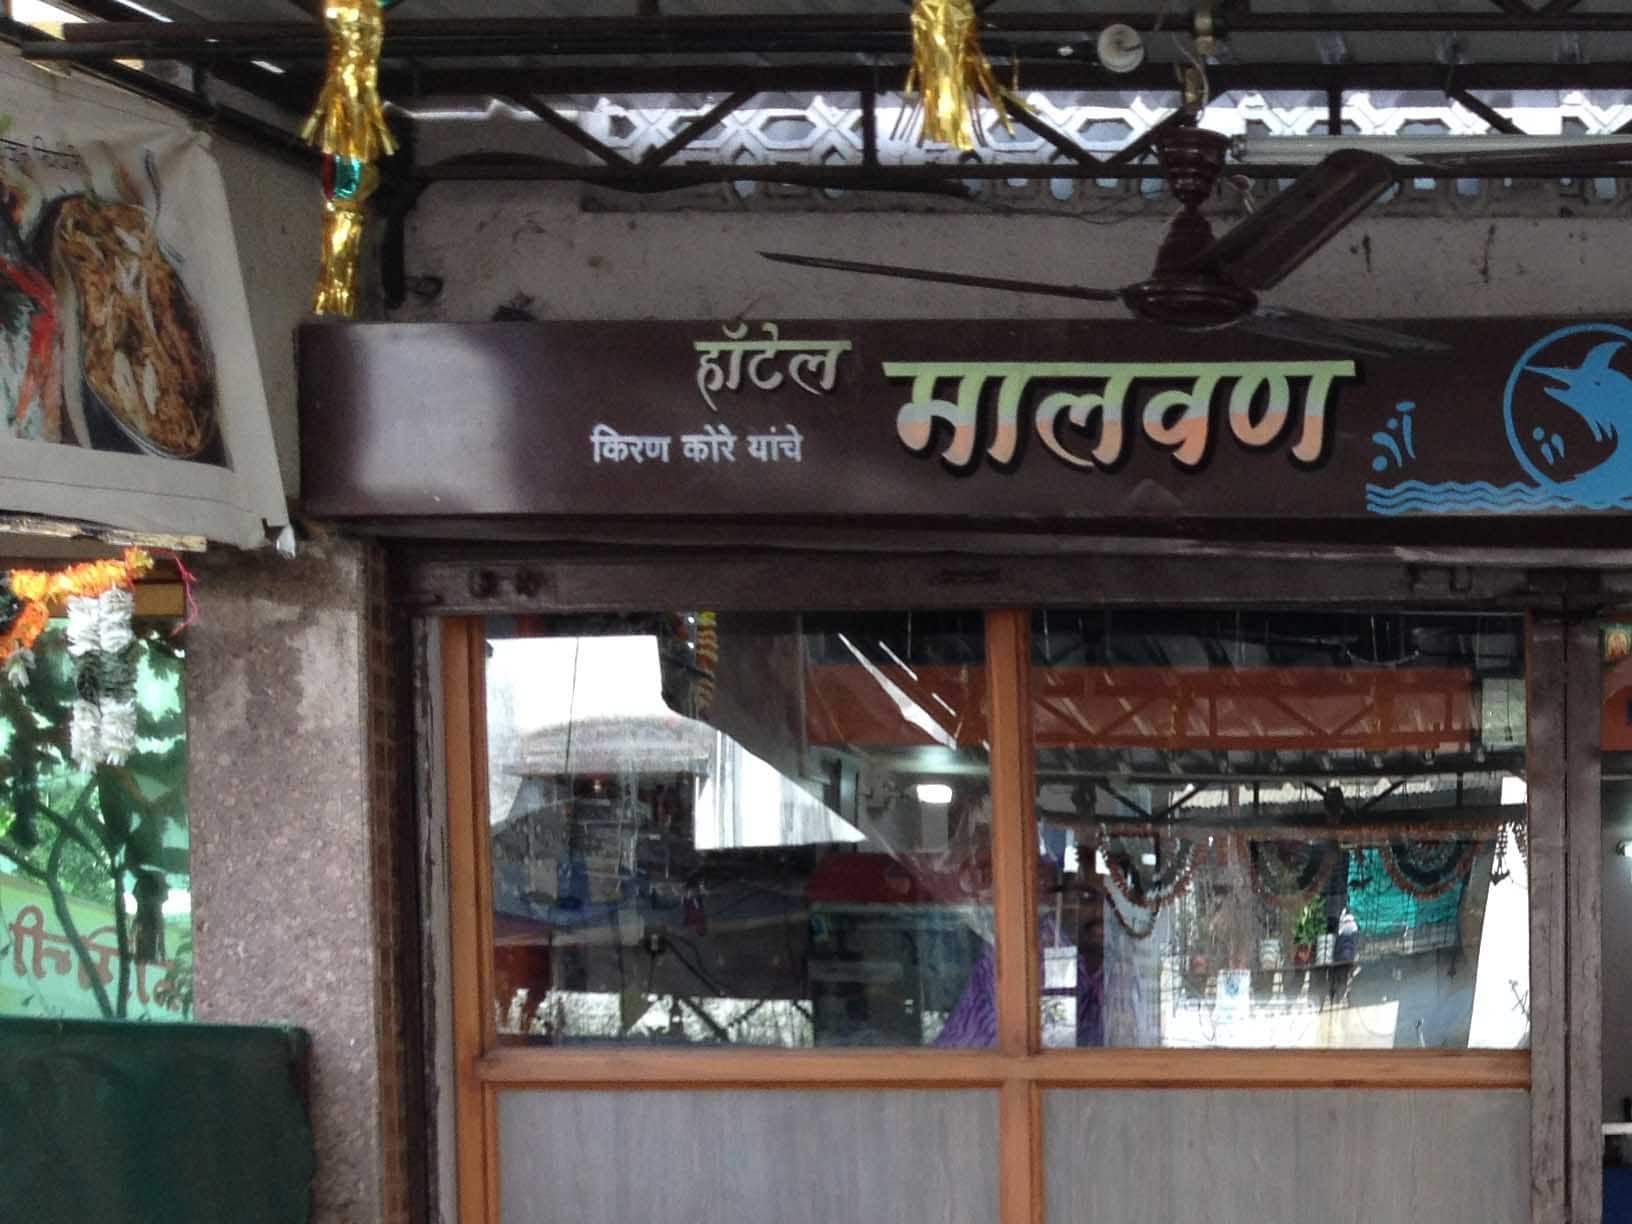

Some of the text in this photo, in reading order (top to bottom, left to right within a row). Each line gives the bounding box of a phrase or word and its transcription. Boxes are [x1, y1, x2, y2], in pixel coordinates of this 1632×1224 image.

[693, 322, 852, 411] हॉटेल
[590, 424, 804, 463] किरण कोरे यांचे
[882, 360, 1356, 467] मालवण
